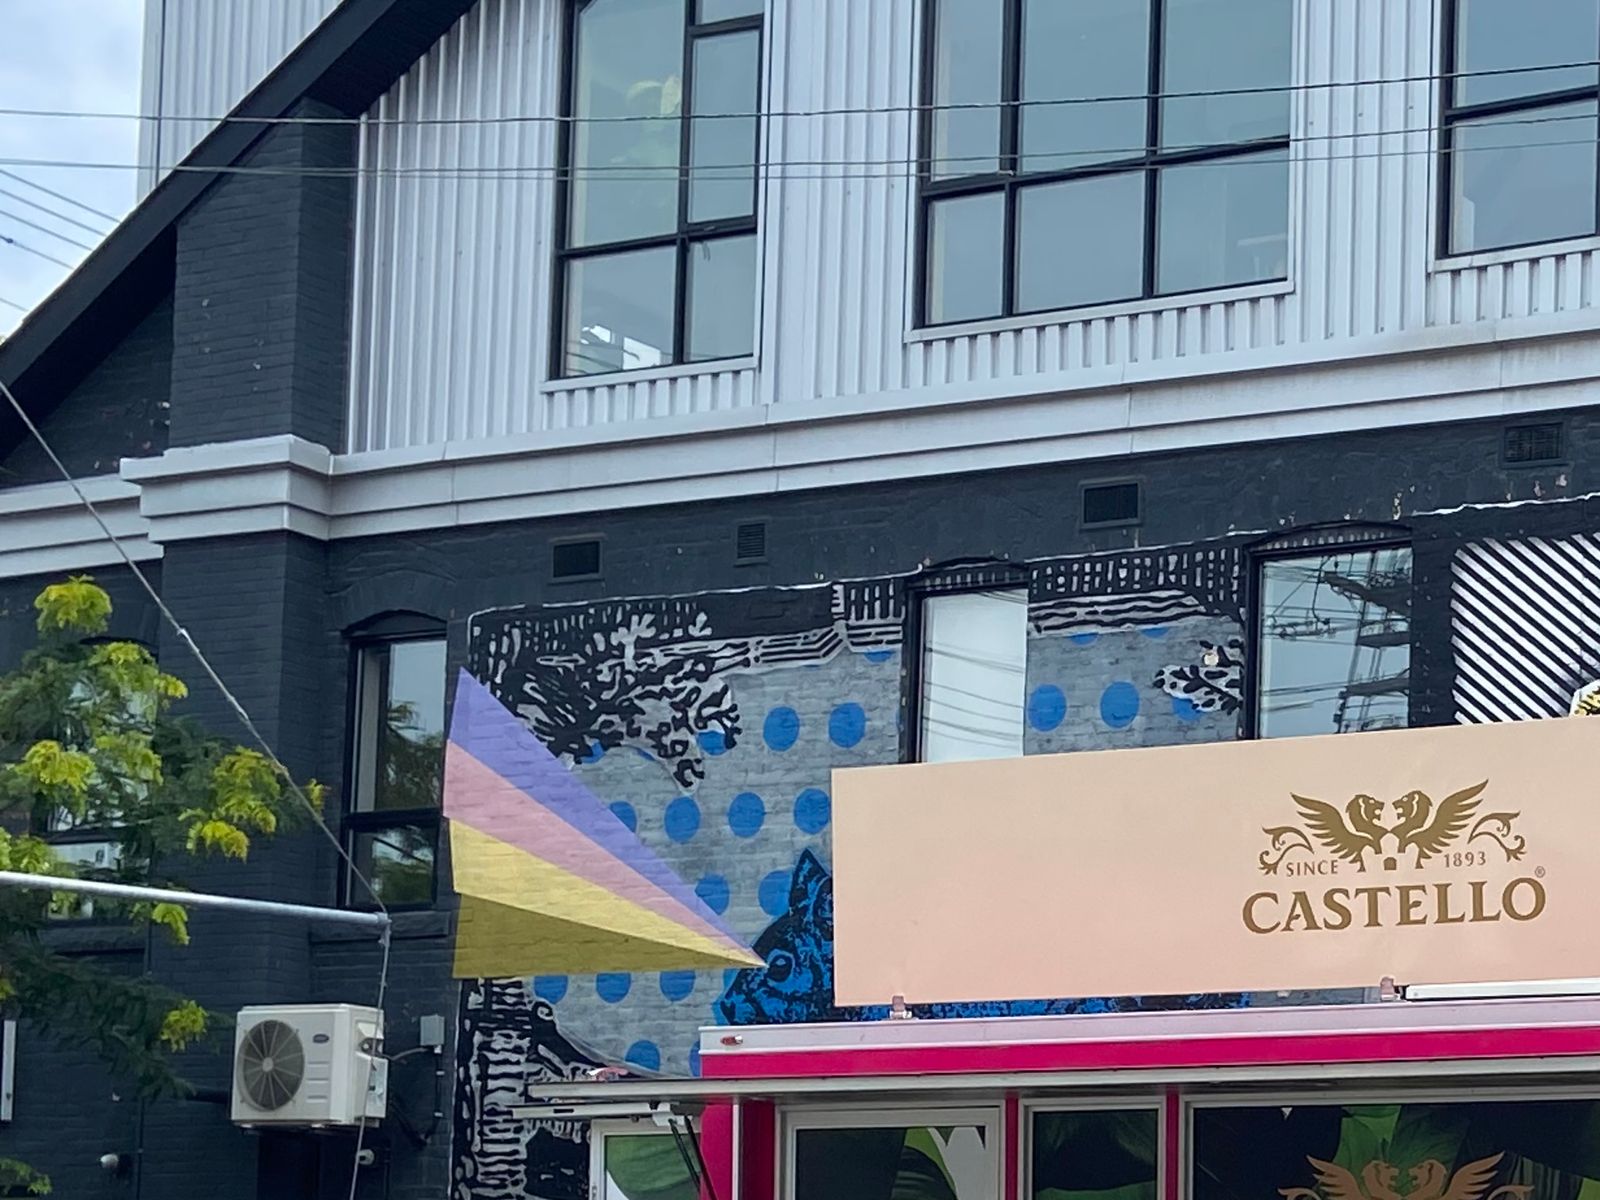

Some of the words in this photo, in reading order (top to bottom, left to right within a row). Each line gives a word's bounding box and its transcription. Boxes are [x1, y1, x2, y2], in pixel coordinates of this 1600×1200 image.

[1285, 860, 1339, 877] SINCE
[1443, 851, 1487, 868] 1893
[1242, 877, 1546, 934] CASTELLO
